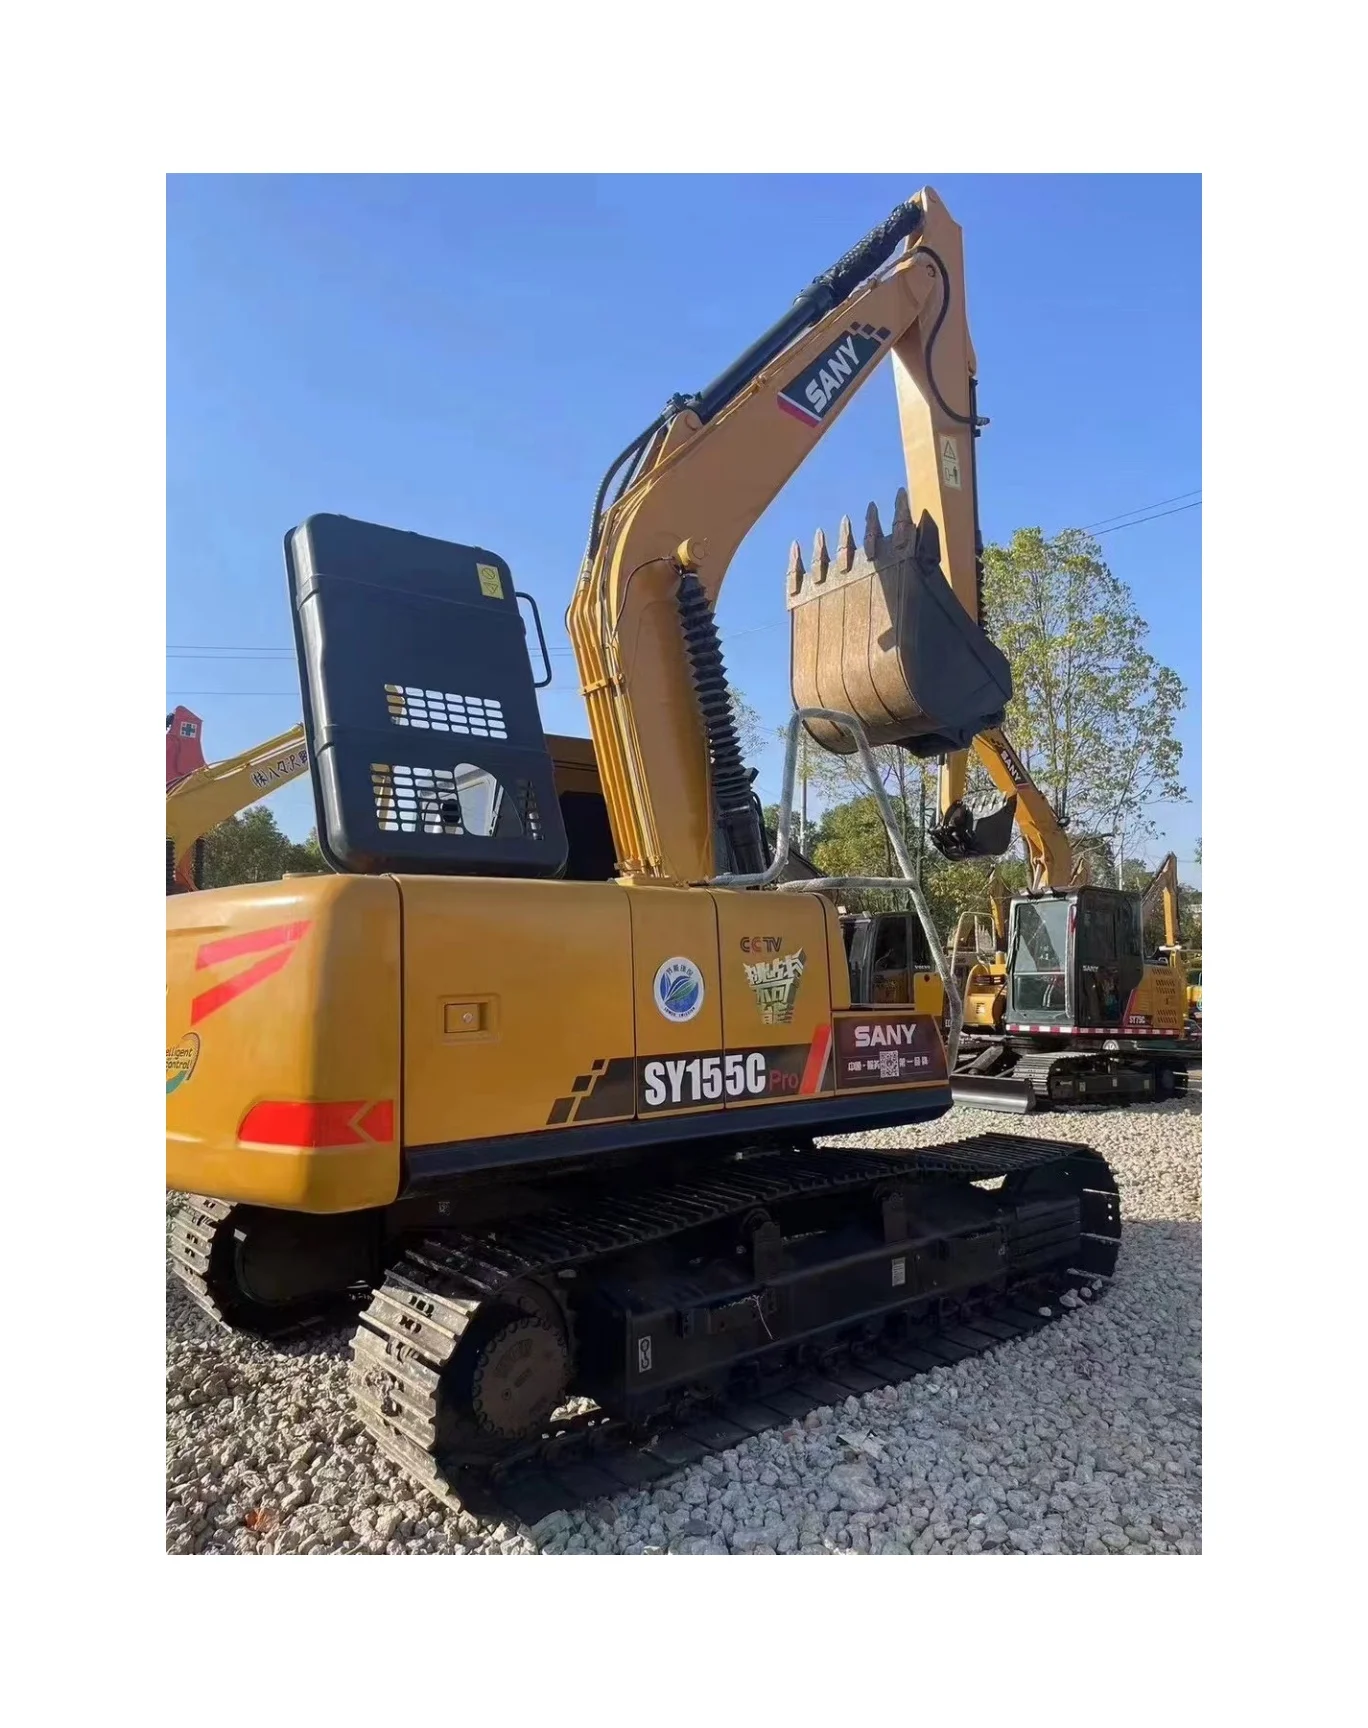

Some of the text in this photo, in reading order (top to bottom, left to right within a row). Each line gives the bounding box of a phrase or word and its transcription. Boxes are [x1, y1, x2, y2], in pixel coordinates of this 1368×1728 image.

[805, 336, 860, 413] SANY
[1001, 750, 1021, 781] SANY
[740, 936, 783, 953] CCTV
[1082, 965, 1099, 973] SANY
[854, 1024, 916, 1048] SANY
[644, 1052, 799, 1106] SY155C Pro
